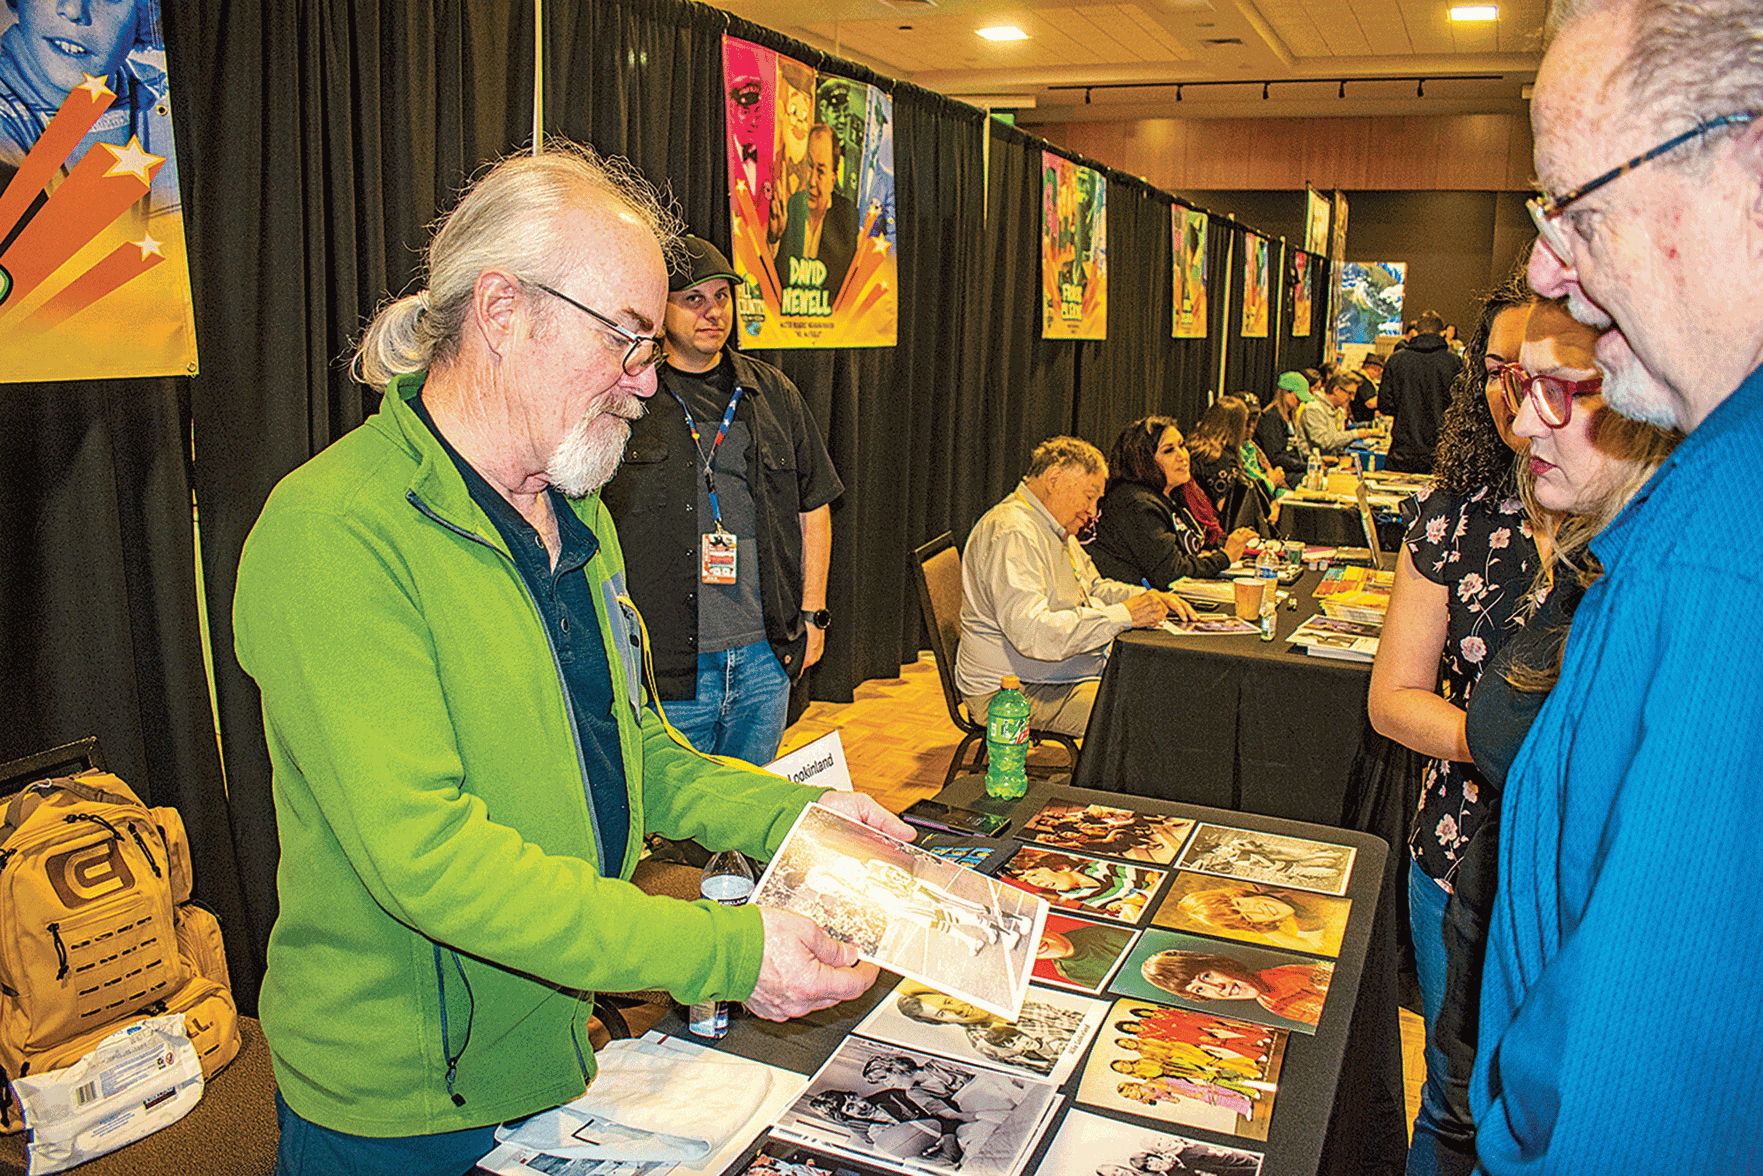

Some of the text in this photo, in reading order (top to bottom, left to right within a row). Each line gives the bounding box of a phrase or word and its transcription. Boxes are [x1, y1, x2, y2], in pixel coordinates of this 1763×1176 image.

[788, 256, 828, 288] DAVID
[780, 286, 833, 317] NEWELL
[786, 752, 835, 784] Lookinland
